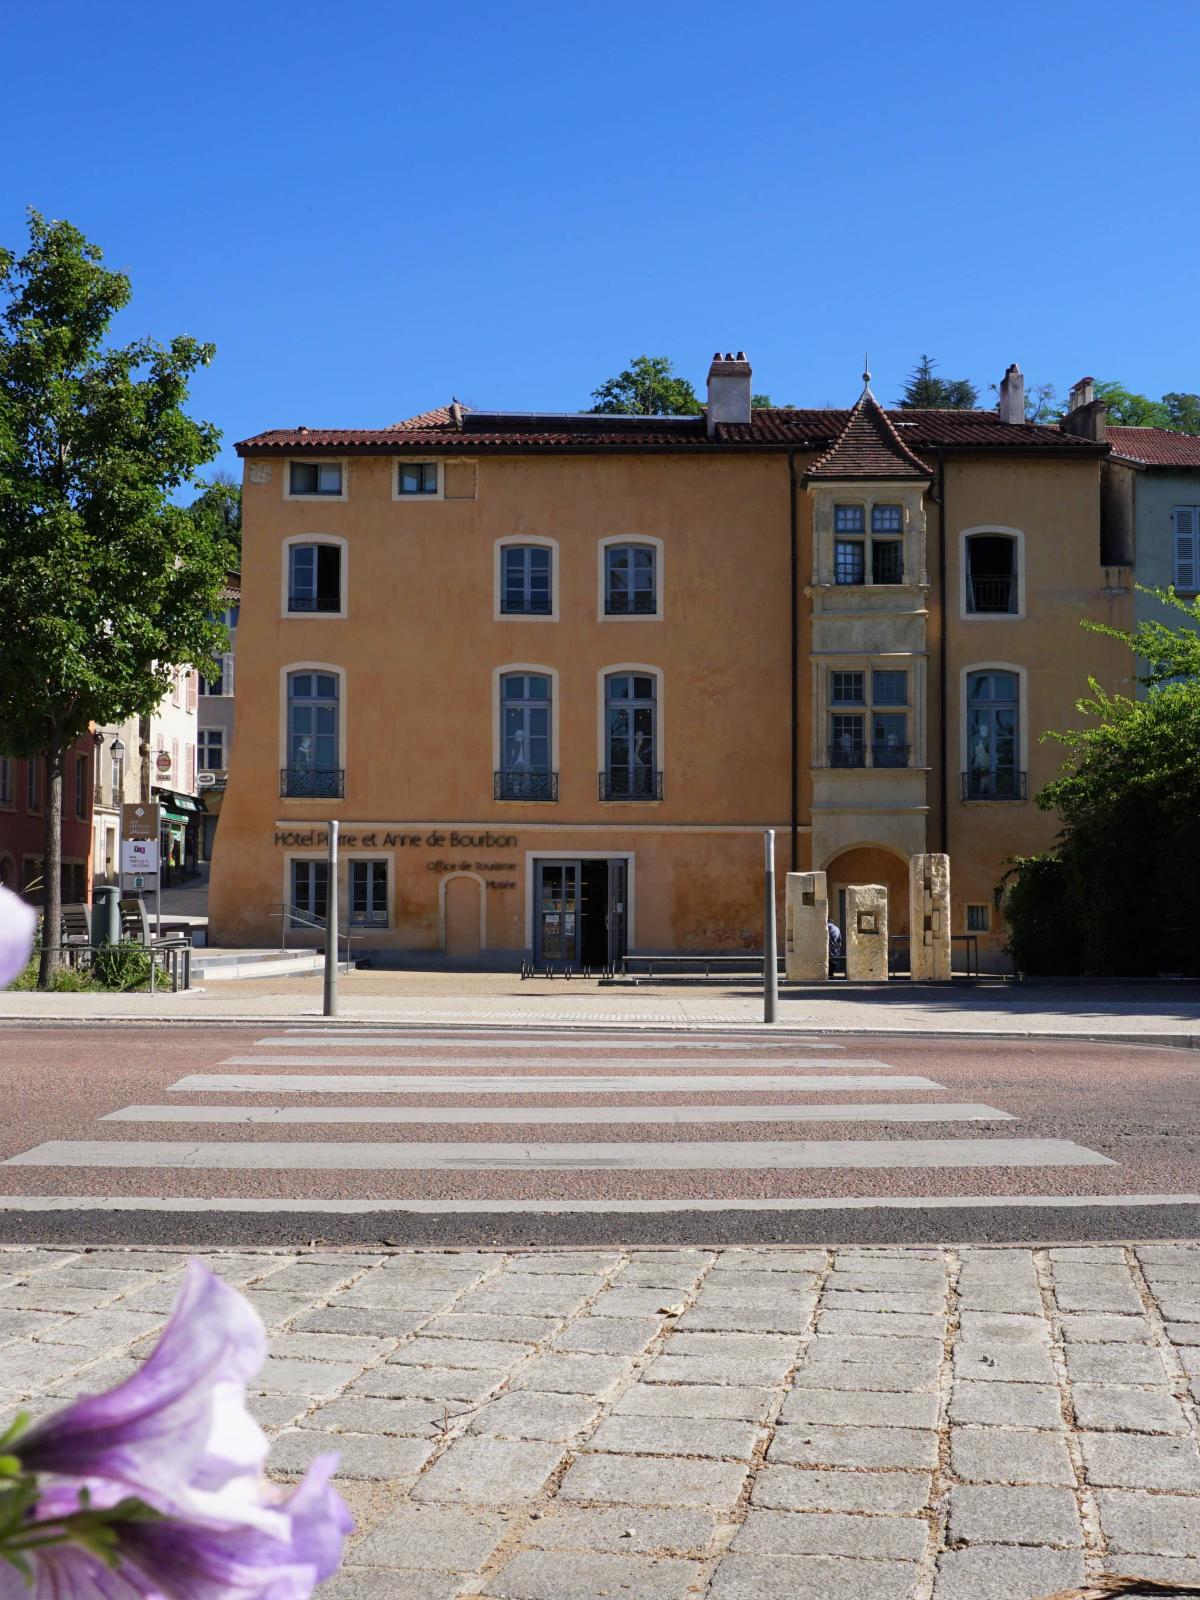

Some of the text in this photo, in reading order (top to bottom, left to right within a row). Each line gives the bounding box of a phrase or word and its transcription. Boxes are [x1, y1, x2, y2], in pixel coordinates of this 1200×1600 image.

[274, 830, 517, 847] Hôtel Pirre et Anne de Bourbon
[426, 860, 516, 873] Office de Tourisme
[486, 879, 516, 889] Musée
